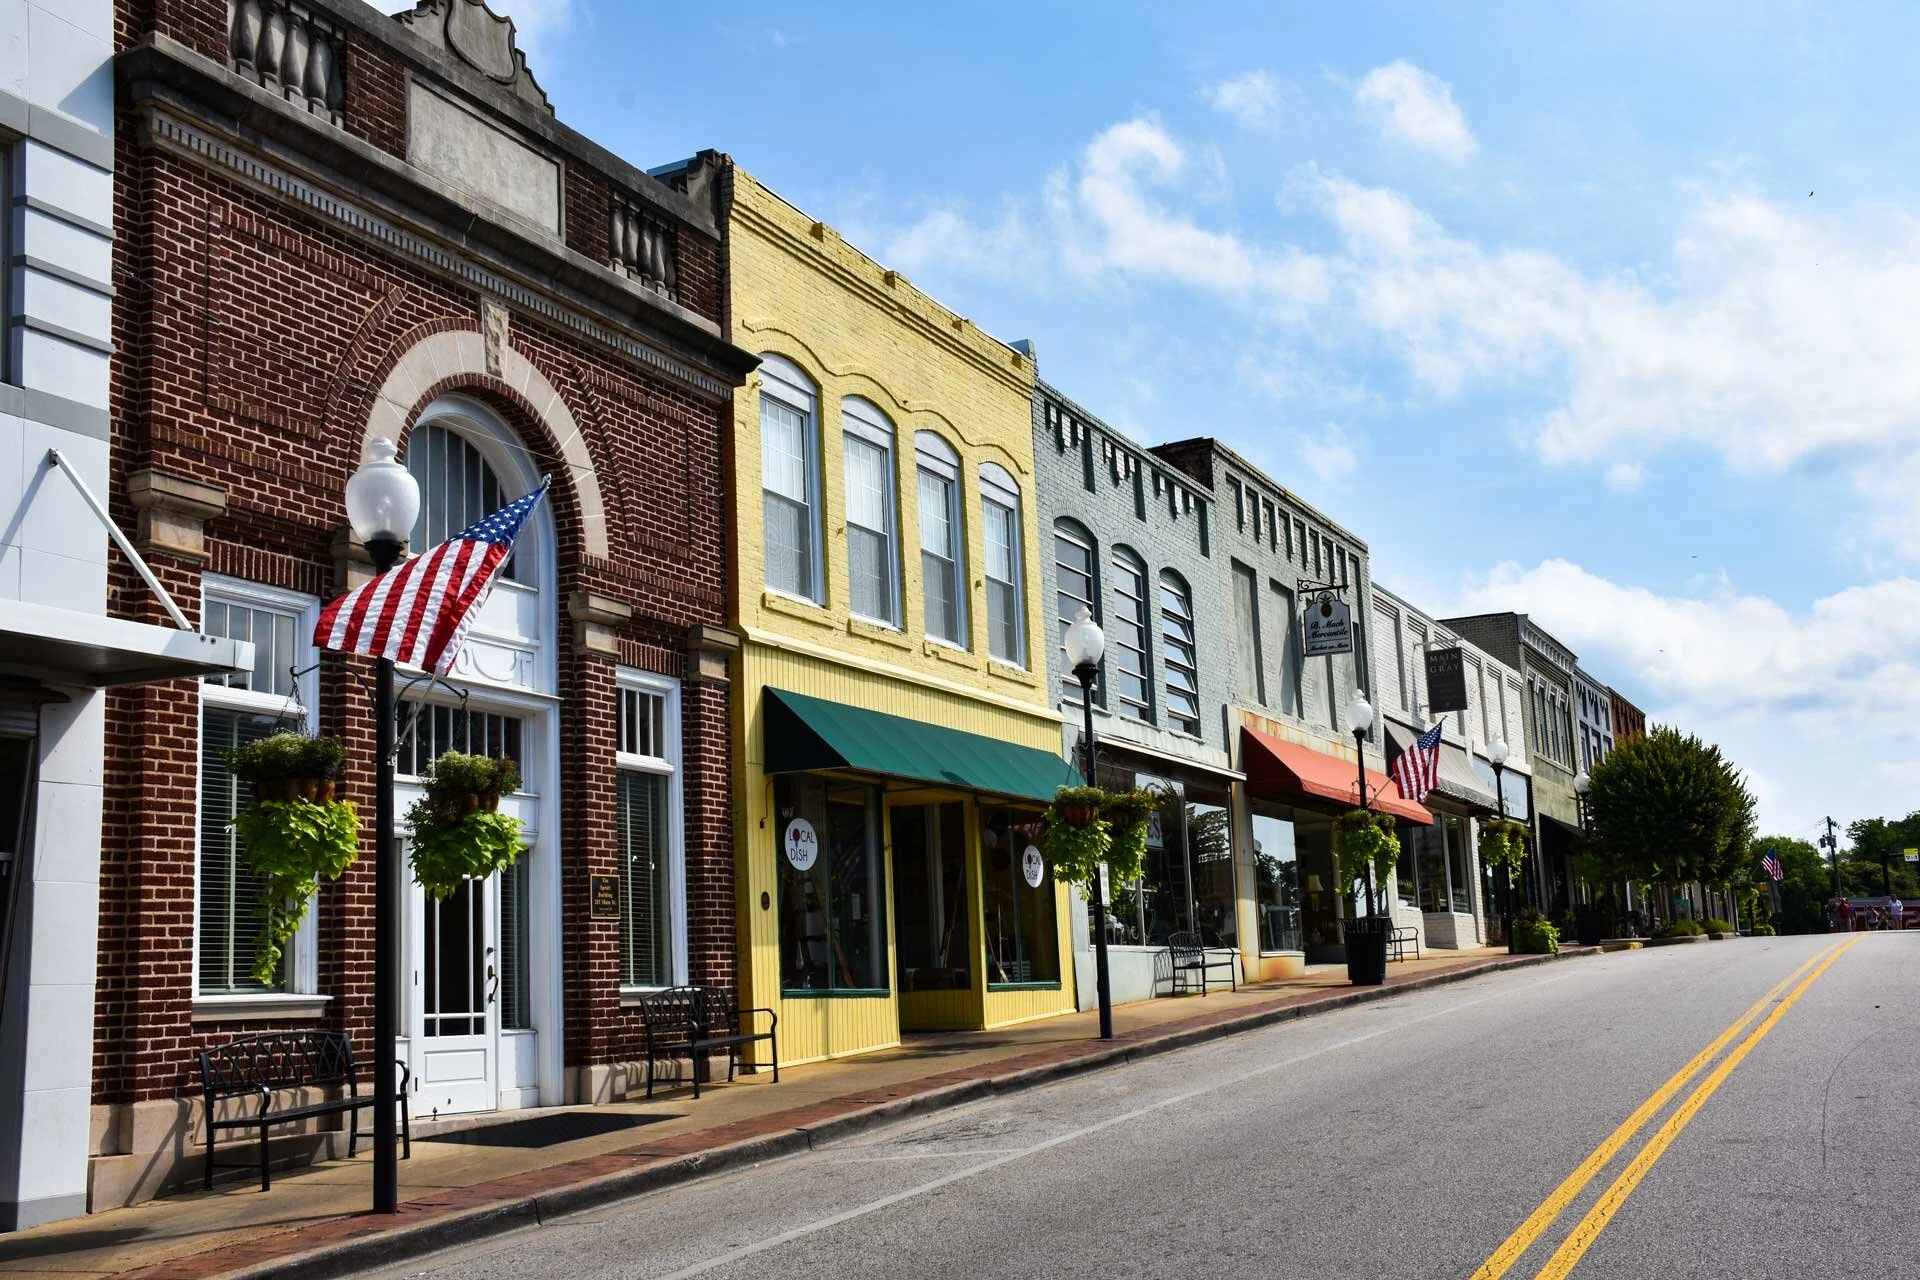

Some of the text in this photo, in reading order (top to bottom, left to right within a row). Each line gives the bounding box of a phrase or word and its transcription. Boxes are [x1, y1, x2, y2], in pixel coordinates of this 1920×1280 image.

[1310, 618, 1345, 630] B. Mack
[1307, 627, 1349, 640] Mercantile
[1430, 652, 1459, 662] MAIN
[1430, 663, 1459, 673] GRAY
[789, 828, 816, 844] LOCAL
[790, 848, 808, 862] DISH
[1025, 854, 1042, 866] LOCAL
[1026, 869, 1039, 880] DISH
